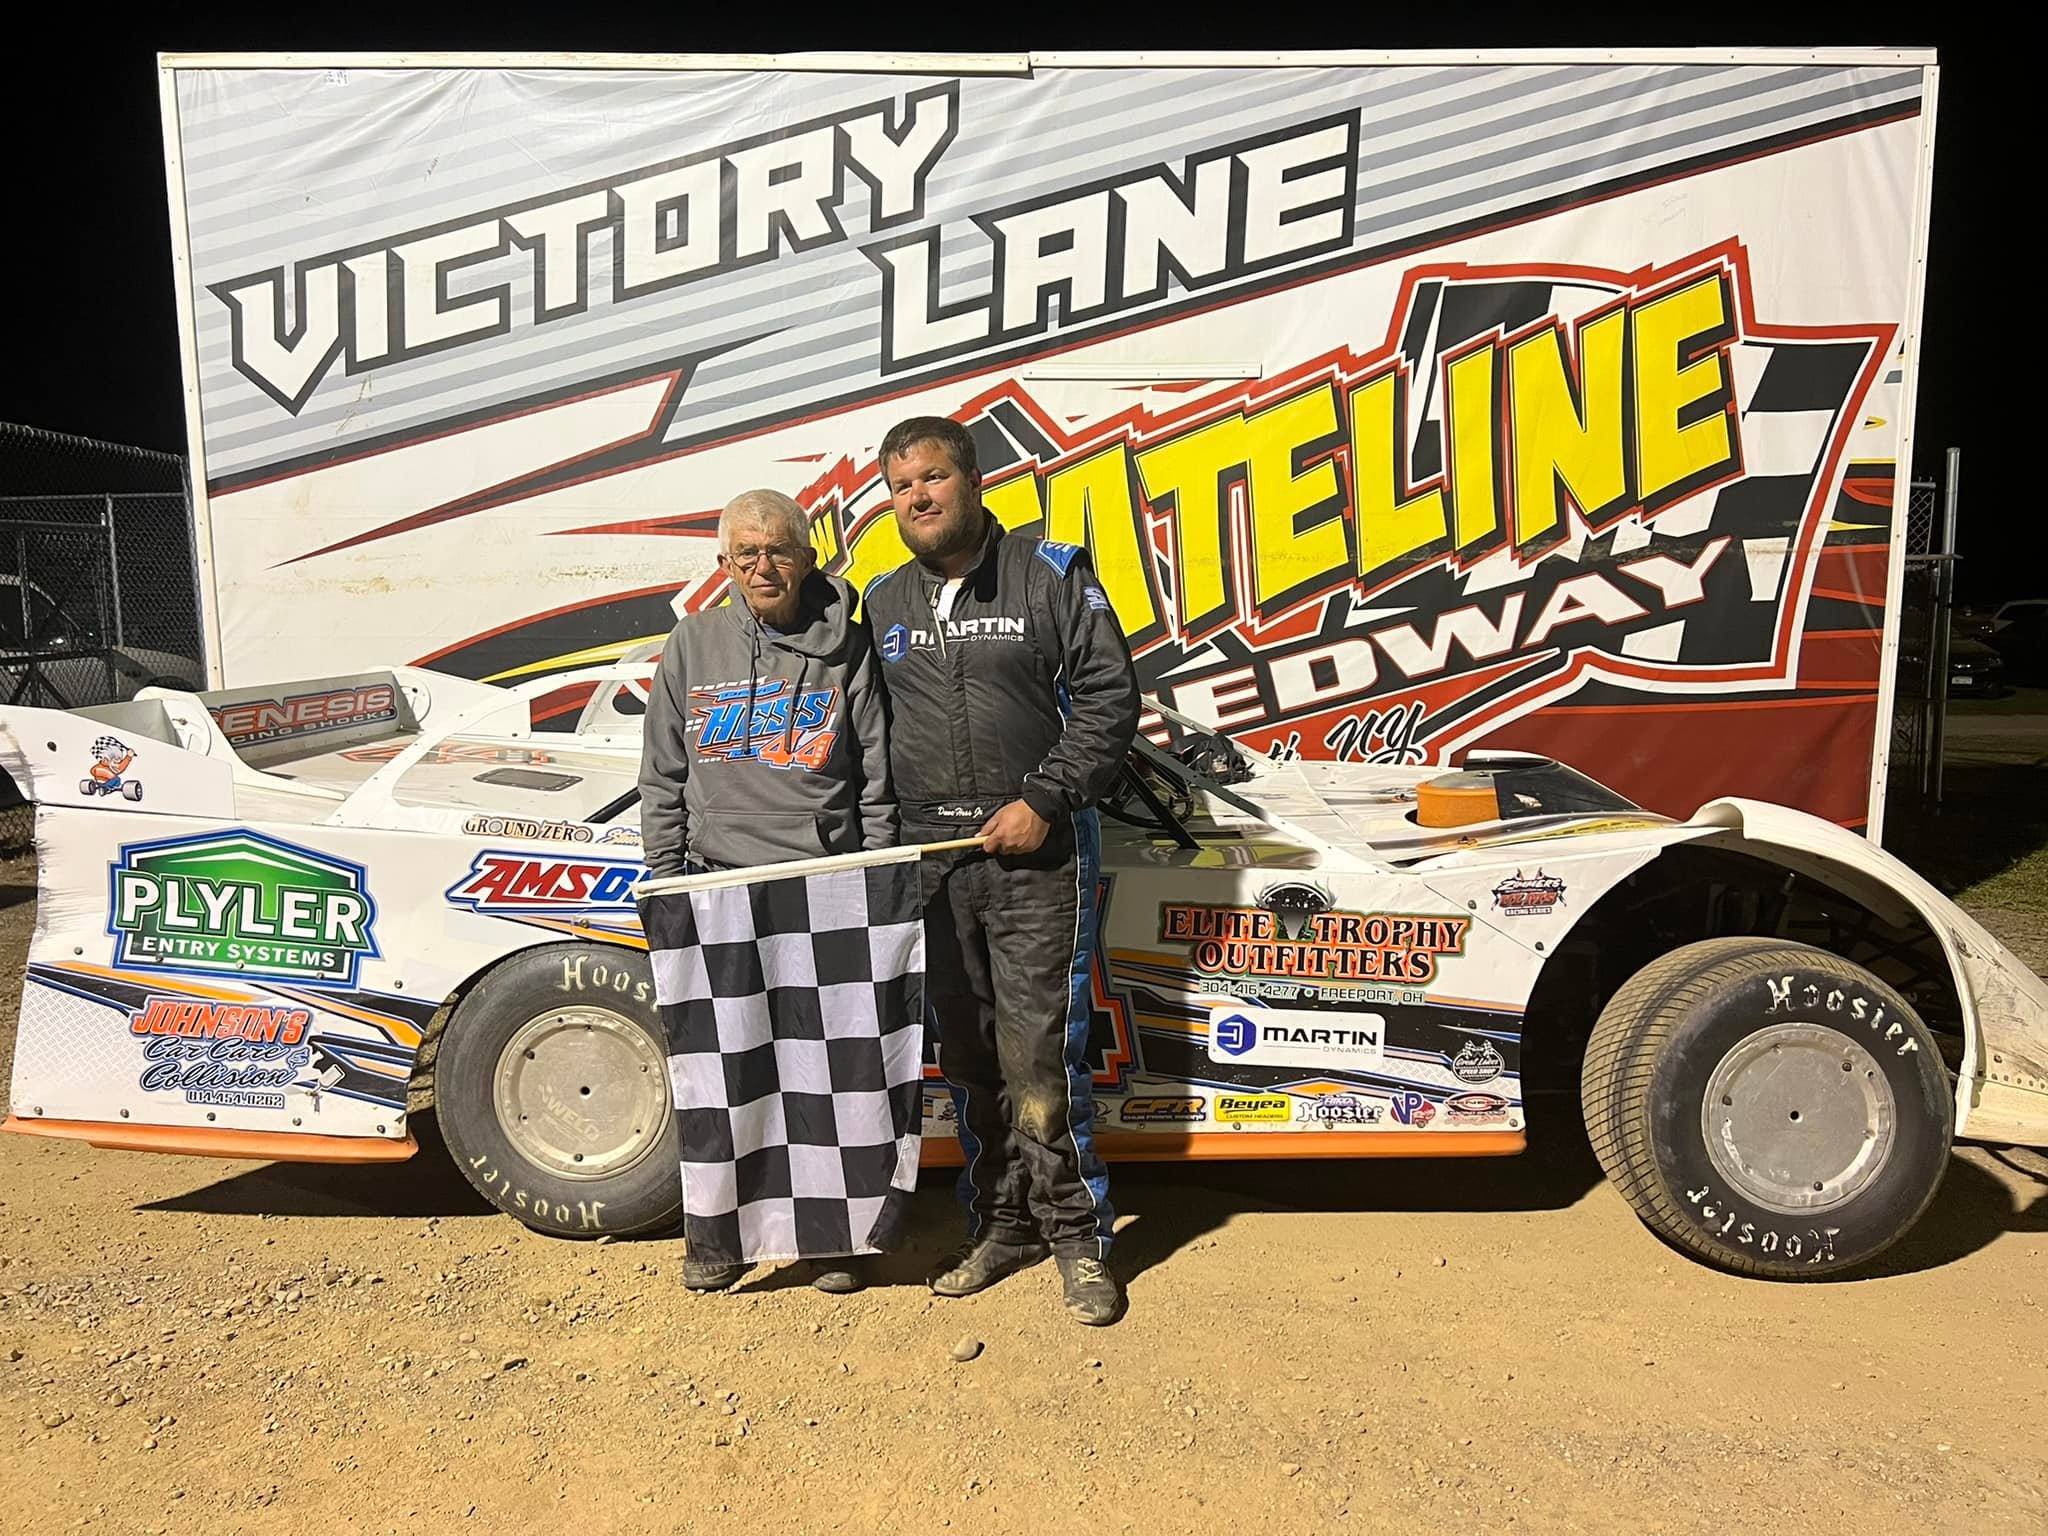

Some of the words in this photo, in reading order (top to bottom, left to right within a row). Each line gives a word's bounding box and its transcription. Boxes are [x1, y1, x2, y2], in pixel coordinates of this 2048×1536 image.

[205, 79, 960, 416] VICTORY
[857, 107, 1361, 377] LANE
[842, 274, 1732, 638] ATELINE
[970, 633, 1025, 642] DYNAMICS
[1138, 535, 1732, 746] EDWAY
[213, 686, 393, 733] ENESIS
[231, 728, 293, 744] CING
[303, 710, 391, 731] SHOCKS
[698, 689, 835, 748] HESS
[758, 729, 840, 771] 44
[1326, 701, 1426, 764] NY
[464, 817, 538, 839] GROUND
[541, 822, 592, 842] ZERO
[463, 858, 652, 904] AMSO
[119, 873, 365, 946] PLYLER
[1163, 905, 1274, 941] ELITE
[1312, 914, 1467, 952] TROPHY
[142, 936, 219, 957] ENTRY
[227, 943, 336, 968] SYSTEMS
[1196, 941, 1433, 980] OUTFITTERS
[558, 954, 658, 1012] Hoos
[1202, 981, 1229, 993] 304
[1263, 986, 1298, 998] 4277
[1402, 991, 1423, 1003] OH
[132, 1000, 310, 1045] JOHNSON'S
[1765, 974, 1918, 1055] Hoosier
[146, 1036, 208, 1060] Car
[208, 1036, 288, 1061] Care
[1263, 1027, 1377, 1046] MARTIN
[1322, 1046, 1377, 1055] DYNAMICS
[141, 1061, 297, 1090] Collision
[1219, 1097, 1286, 1112] Beyea
[1296, 1101, 1384, 1122] Hoosier
[1392, 1092, 1423, 1124] VP
